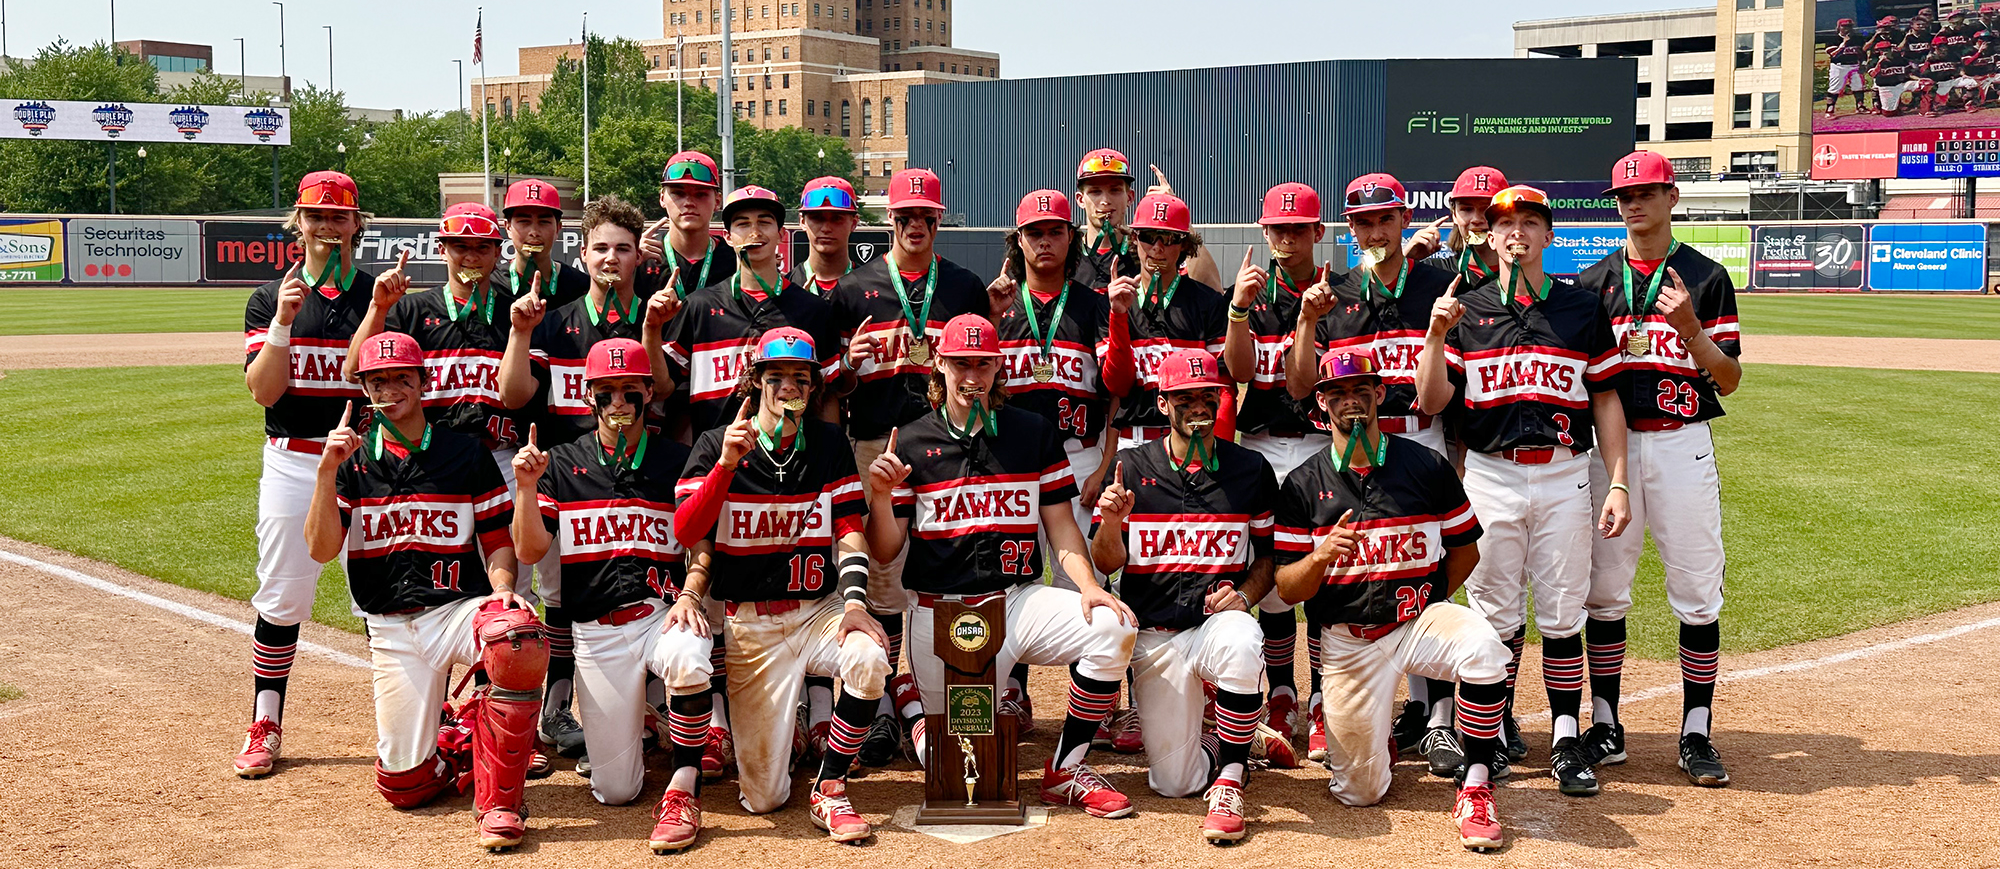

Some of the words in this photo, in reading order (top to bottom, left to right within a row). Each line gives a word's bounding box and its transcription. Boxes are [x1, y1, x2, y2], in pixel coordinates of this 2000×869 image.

[14, 110, 38, 120] DOUBLE
[40, 110, 57, 121] PLAY
[92, 112, 116, 122] DOUBLE
[117, 112, 134, 123] PLAY
[1408, 112, 1460, 134] FIS
[1473, 117, 1523, 125] ADVANCING
[1524, 117, 1541, 125] THE
[1542, 117, 1562, 125] WAY
[1563, 117, 1580, 125] THE
[1581, 117, 1612, 125] WORLD
[1473, 126, 1497, 135] PAYS,
[1498, 126, 1527, 134] BANKS
[1528, 126, 1547, 134] AND
[1952, 131, 1957, 139] 2
[1964, 131, 1970, 139] 3
[1991, 130, 1996, 138] 5
[1989, 141, 1996, 149] 6
[1901, 155, 1928, 164] RUSSIA
[1990, 153, 1996, 161] 0
[1623, 160, 1640, 179] H
[1956, 165, 1963, 173] 0
[909, 176, 925, 195] H
[1473, 173, 1490, 191] H
[526, 184, 541, 200] H
[1036, 195, 1052, 212] H
[1152, 202, 1169, 222] H
[1280, 192, 1297, 213] H
[1549, 198, 1618, 209] MORTGAGE
[84, 227, 165, 241] Securitas
[1553, 236, 1590, 248] Stark
[1592, 236, 1627, 247] State
[1764, 235, 1792, 247] State
[1793, 235, 1807, 246] &
[84, 243, 184, 260] Technology
[217, 233, 305, 271] meije
[1763, 244, 1805, 257] Federal
[1814, 238, 1852, 270] 30
[1892, 248, 1948, 259] Cleveland
[1950, 248, 1983, 259] Clinic
[965, 326, 982, 348] H
[378, 339, 396, 359] H
[289, 353, 346, 381] HAW
[608, 348, 627, 370] H
[1188, 357, 1206, 378] H
[424, 363, 500, 393] HAWK
[1478, 360, 1575, 394] HAWKS
[1656, 379, 1700, 418] 23
[1058, 397, 1087, 437] 24
[1552, 412, 1575, 447] 3
[934, 489, 1030, 523] HAWKS
[362, 509, 459, 542] HAWKS
[570, 513, 669, 547] HAWKS
[1139, 529, 1242, 558] HAWKS
[1000, 540, 1035, 575] 27
[430, 560, 462, 592] 11
[787, 553, 825, 592] 16
[956, 626, 983, 636] OHSAA
[960, 708, 982, 717] 2023
[952, 724, 988, 732] BASEBALL
